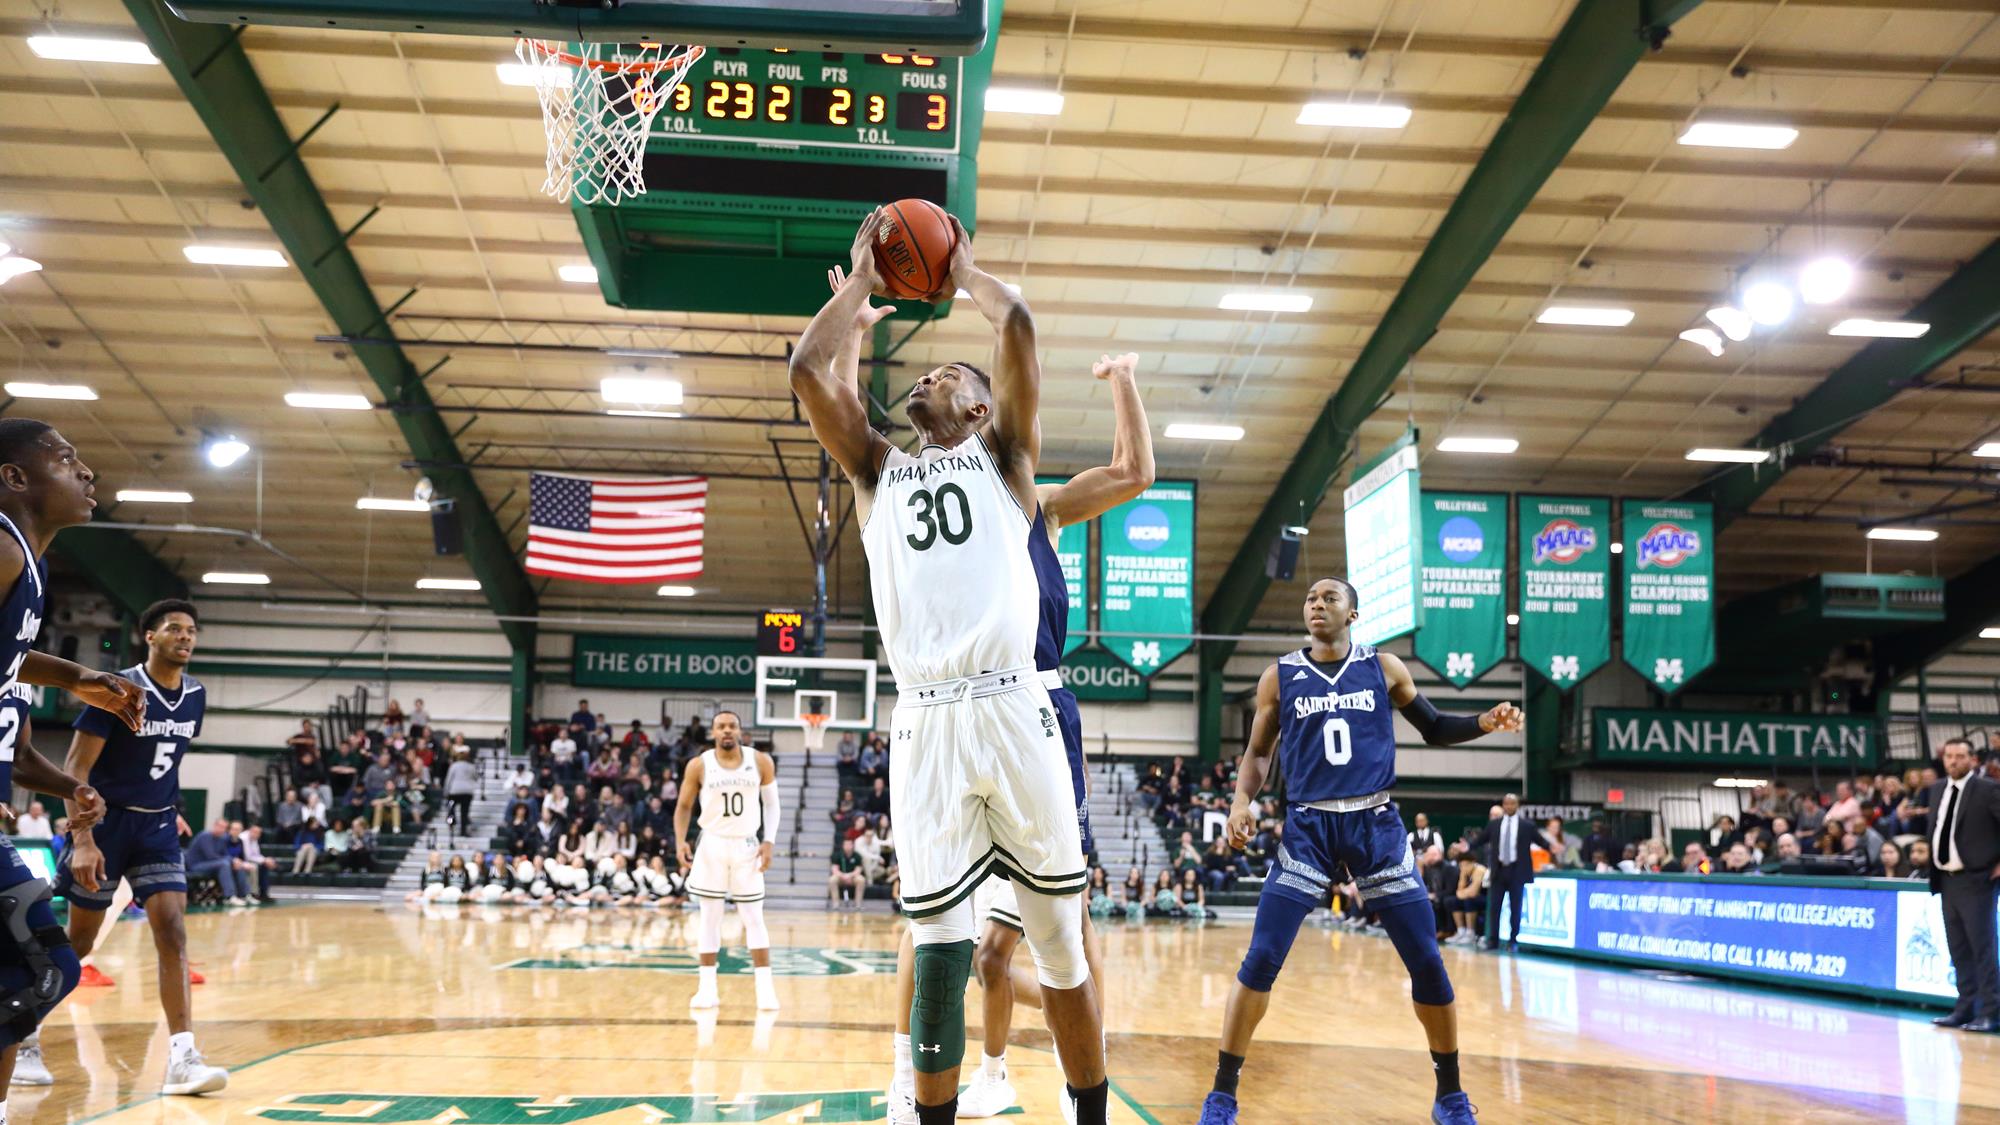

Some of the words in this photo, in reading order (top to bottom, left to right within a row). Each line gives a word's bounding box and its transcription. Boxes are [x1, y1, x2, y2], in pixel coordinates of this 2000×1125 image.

[713, 60, 748, 78] PLYR
[768, 64, 804, 81] FOUL
[821, 67, 848, 83] PTS
[902, 72, 947, 89] FOULS
[675, 83, 691, 111] 3
[707, 81, 754, 119] 23
[768, 85, 790, 121] 2
[829, 89, 851, 125] 2
[869, 95, 885, 123] 3
[927, 94, 946, 130] 3
[662, 116, 701, 133] T.O.L.
[857, 128, 895, 144] T.O.L.
[887, 240, 917, 279] ROCK
[906, 482, 973, 551] 30
[1434, 500, 1488, 512] VOLLEYBALL
[1538, 504, 1591, 516] VOLLEYBALL
[1128, 526, 1169, 541] NCAA
[1442, 537, 1482, 552] NCAA
[1533, 527, 1596, 562] MAAC
[1638, 531, 1700, 564] MAAC
[1106, 556, 1187, 571] TOURNAMENT
[1422, 567, 1502, 581] TOURNAMENT
[1106, 570, 1188, 584] APPEARANCES
[1422, 581, 1501, 596] APPEARANCES
[1526, 570, 1604, 585] TOURNAMENT
[1527, 584, 1604, 600] CHAMPIONS
[1630, 586, 1709, 602] CHAMPIONS
[779, 626, 795, 653] 6
[583, 651, 630, 672] THE
[634, 654, 681, 674] 6TH
[1323, 718, 1352, 766] 0
[1606, 718, 1867, 759] MANHATTAN
[150, 742, 177, 780] 5
[721, 792, 744, 817] 10
[1589, 892, 1620, 911] OFFICIAL
[1621, 894, 1639, 912] TAX
[1638, 894, 1659, 913] PREP
[1658, 896, 1681, 915] FIRM
[1680, 897, 1694, 916] OF
[1694, 898, 1714, 917] THE
[1713, 899, 1776, 922] MANHATTAN
[1777, 902, 1827, 926] COLLEGE
[1827, 905, 1876, 930] JASPERS
[1597, 931, 1618, 949] VISIT
[1712, 942, 1727, 963] OR
[1728, 944, 1753, 967] CALL
